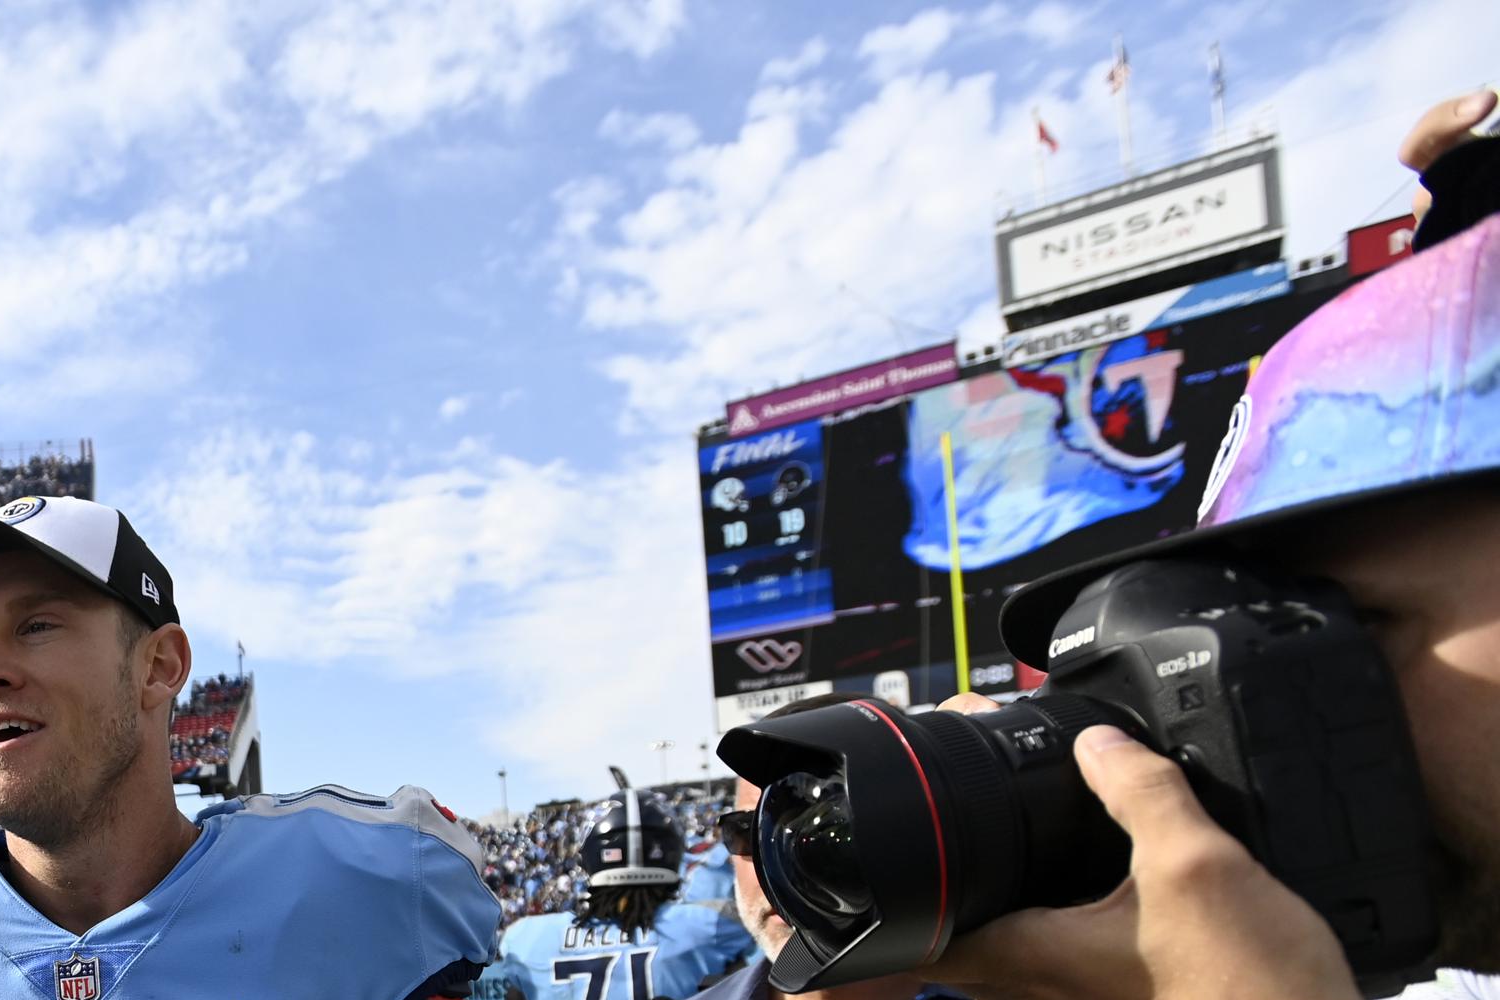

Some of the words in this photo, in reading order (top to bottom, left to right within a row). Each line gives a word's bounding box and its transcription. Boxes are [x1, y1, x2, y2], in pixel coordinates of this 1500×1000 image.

[1040, 189, 1227, 261] NISSAN
[711, 429, 808, 474] FINAL
[1049, 626, 1095, 658] Canon
[62, 977, 94, 1000] NFL
